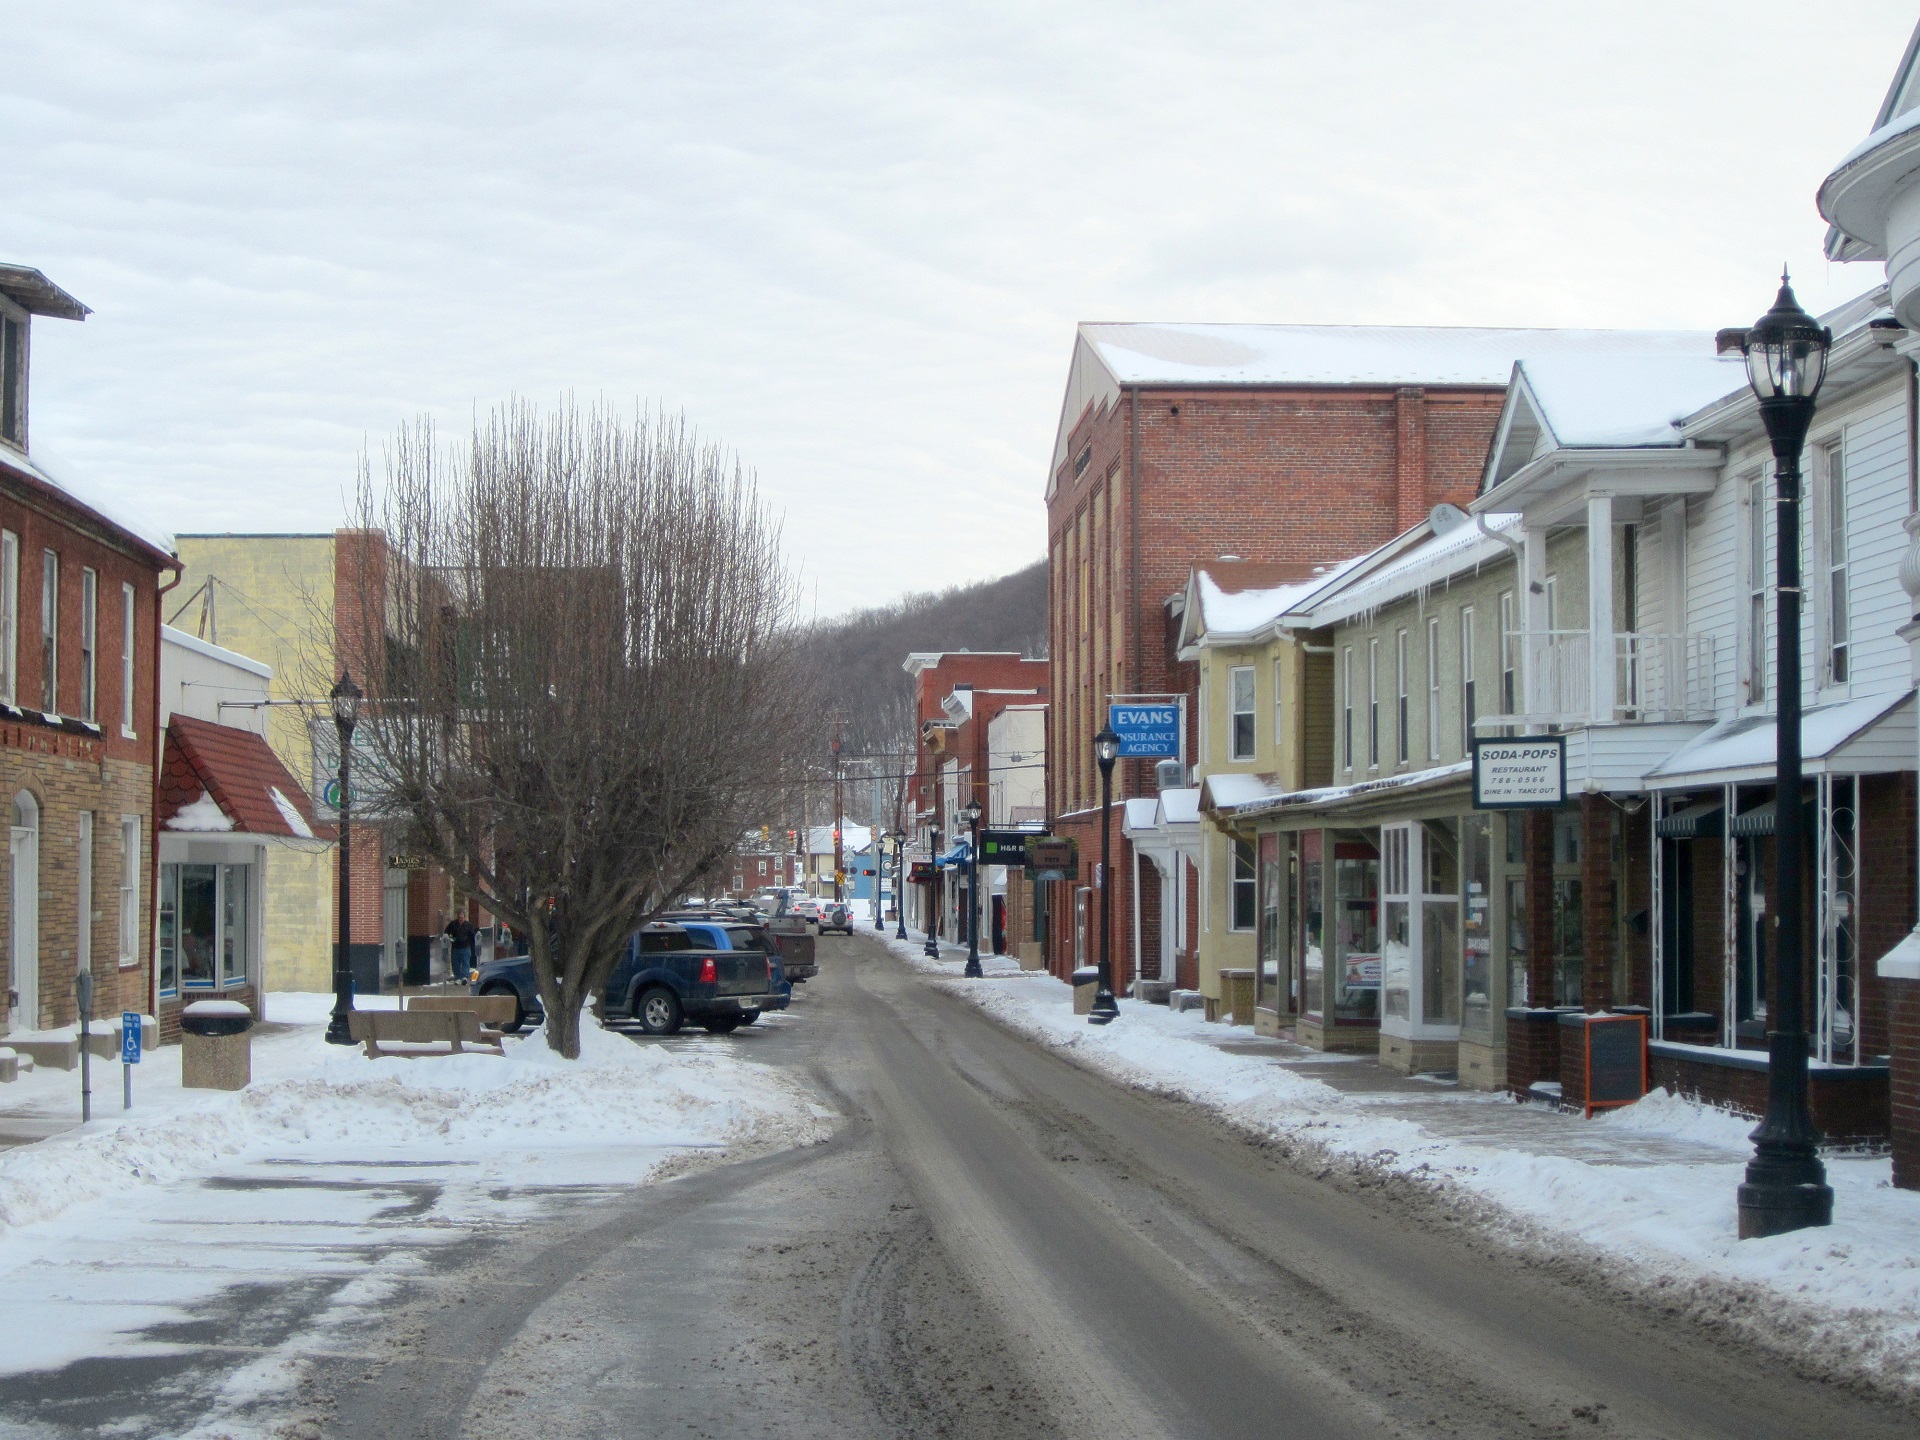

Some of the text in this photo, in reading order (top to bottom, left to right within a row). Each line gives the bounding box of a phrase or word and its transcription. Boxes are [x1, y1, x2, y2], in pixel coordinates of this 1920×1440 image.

[1117, 711, 1174, 725] EVANS
[1127, 743, 1169, 752] AGENCY
[1481, 748, 1558, 760] SODA-POPS
[1491, 765, 1548, 774] RESTAURANT
[1000, 844, 1017, 852] H&R
